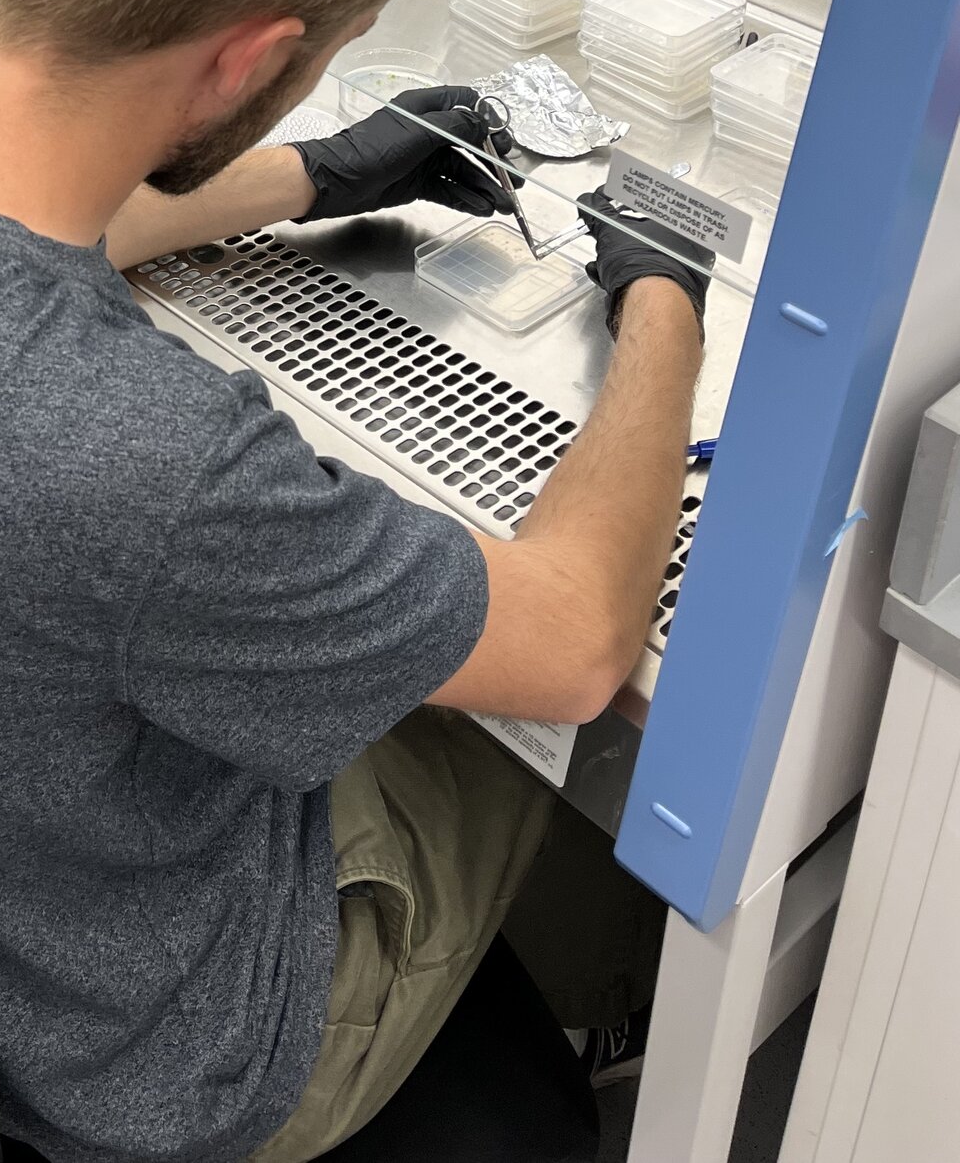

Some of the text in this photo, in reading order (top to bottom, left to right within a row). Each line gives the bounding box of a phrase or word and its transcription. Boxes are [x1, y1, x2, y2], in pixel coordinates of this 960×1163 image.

[622, 174, 633, 184] DO
[634, 180, 649, 191] NOT
[651, 188, 666, 200] PUT
[667, 197, 692, 213] LAMPS
[693, 209, 701, 218] IN
[629, 168, 653, 184] LAMPS
[654, 181, 687, 201] CONTAIN
[622, 184, 725, 241] RECYCLE OR DISPOSE OF AS
[634, 199, 678, 227] HAZARDOUS
